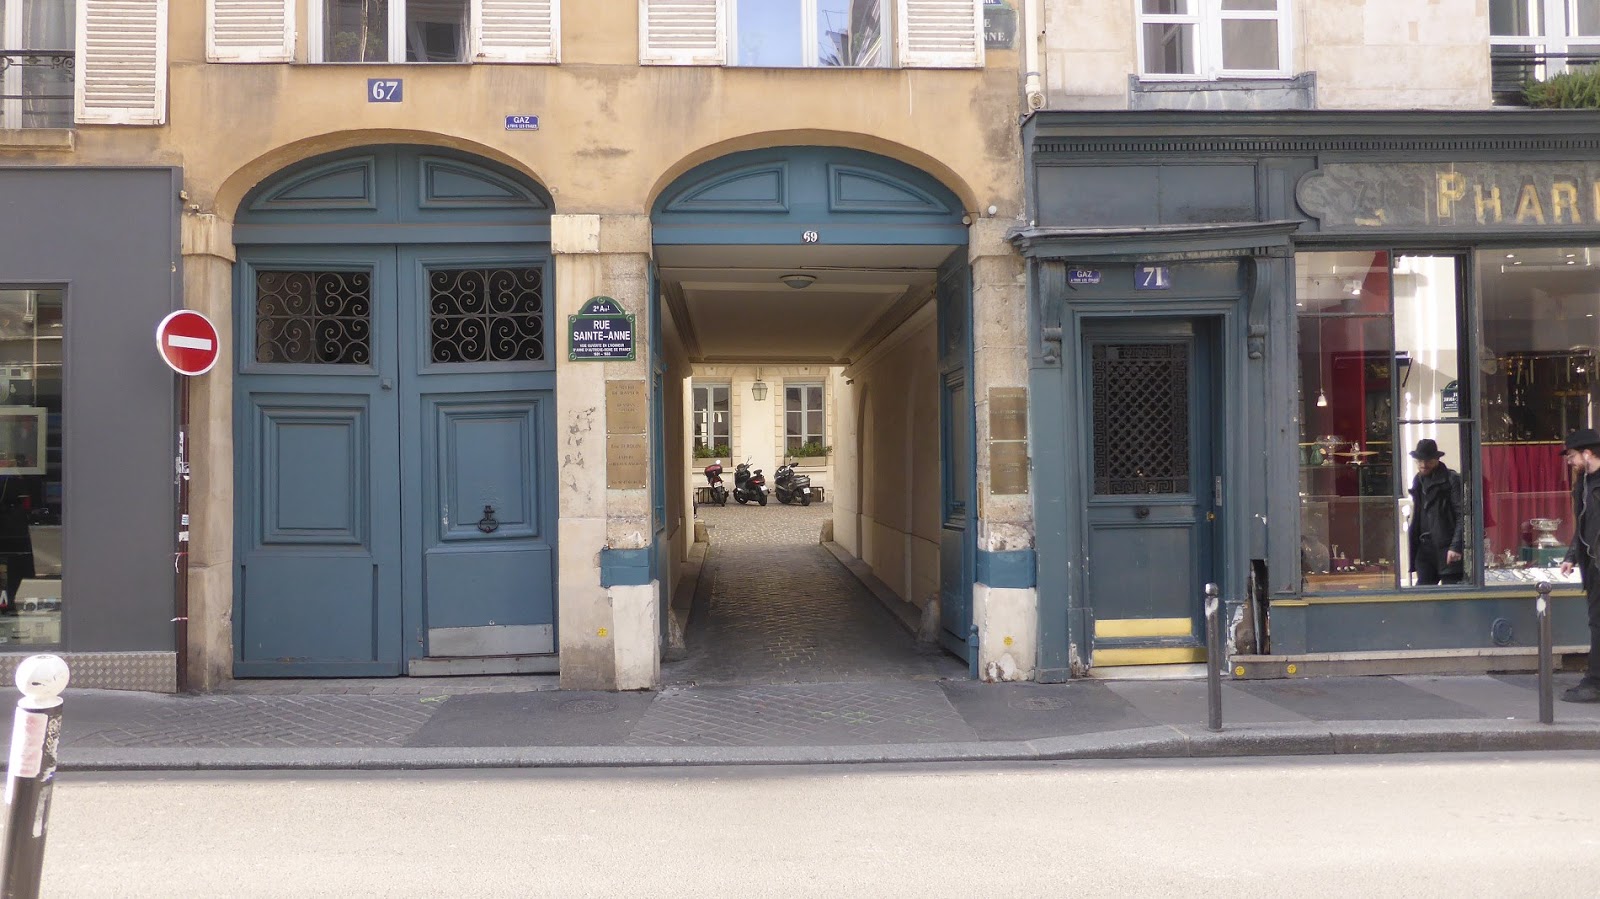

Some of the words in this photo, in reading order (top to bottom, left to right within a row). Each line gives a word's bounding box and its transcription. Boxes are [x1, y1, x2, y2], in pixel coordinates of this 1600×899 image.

[372, 81, 398, 100] 67
[513, 116, 530, 124] GAZ
[1435, 171, 1600, 226] PHAR
[803, 230, 818, 243] 69
[1076, 270, 1093, 278] GAZ
[1143, 266, 1163, 287] 71
[593, 320, 611, 330] RUE
[573, 331, 631, 341] SAINTE-ANNE
